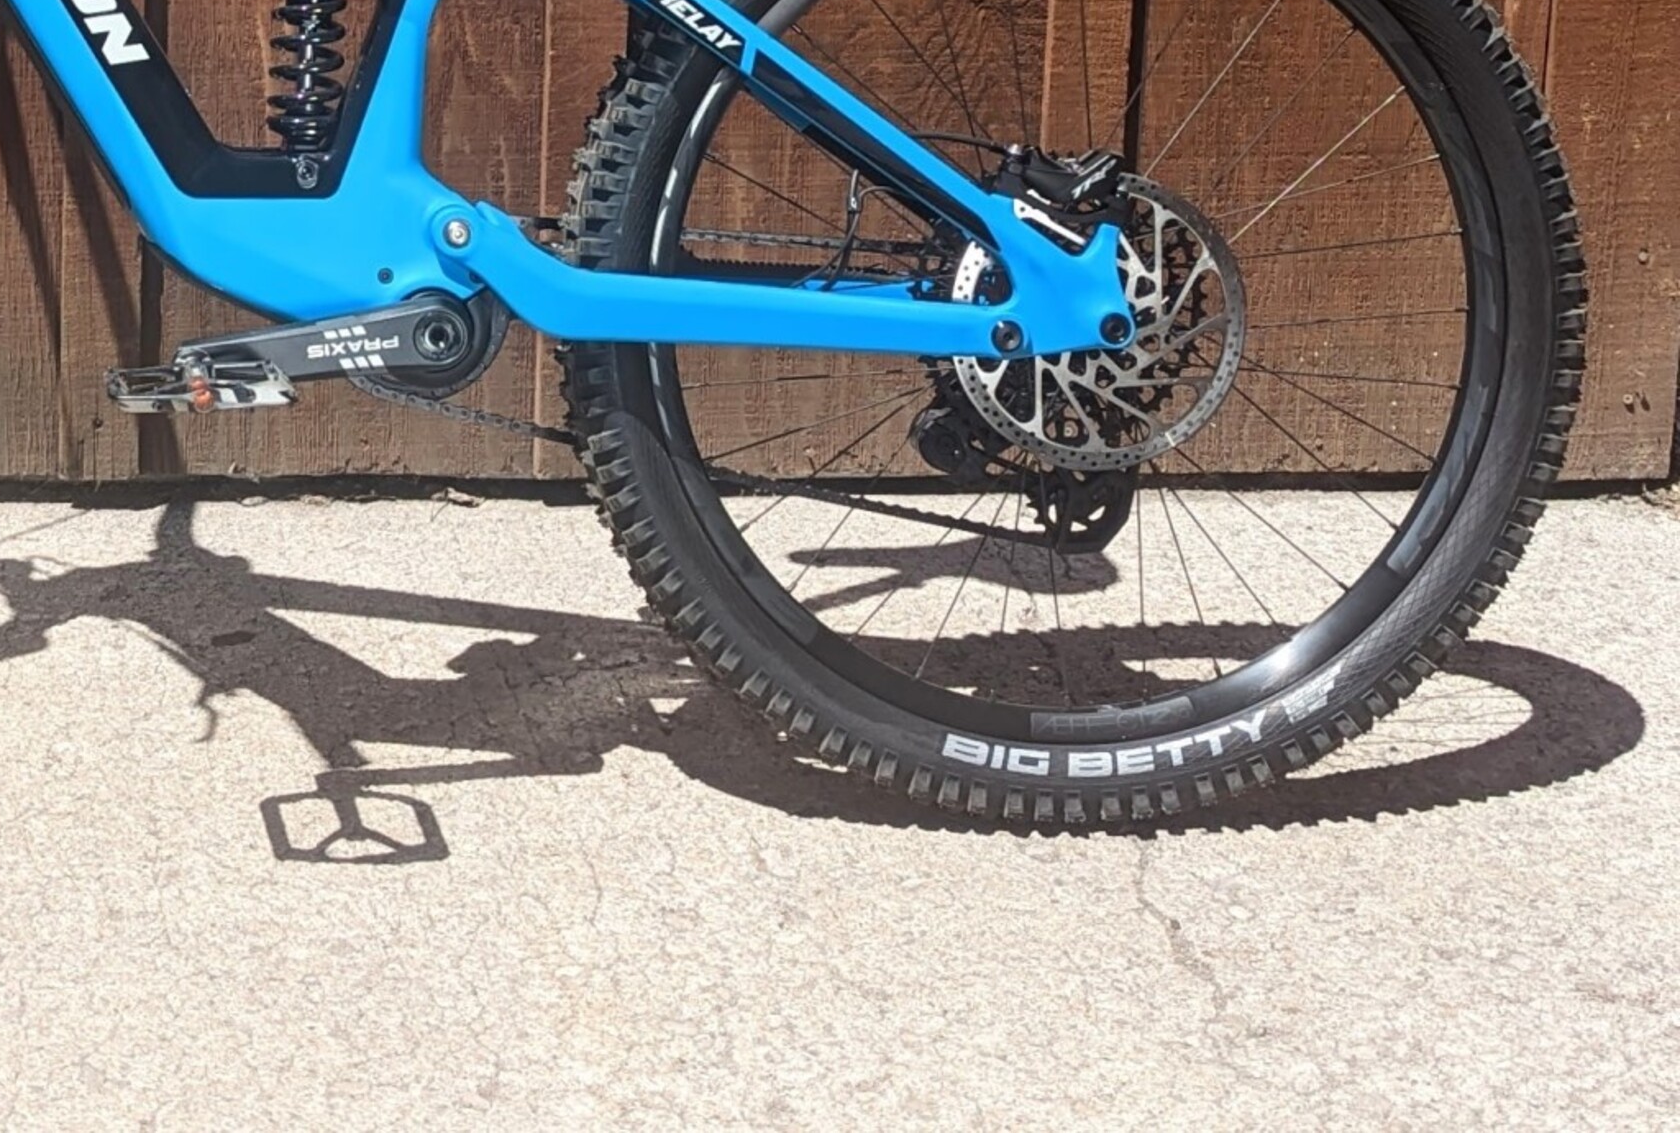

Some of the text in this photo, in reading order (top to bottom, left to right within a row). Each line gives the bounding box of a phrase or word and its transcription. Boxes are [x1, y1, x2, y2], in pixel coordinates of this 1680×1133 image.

[306, 334, 400, 360] PRAXIS
[941, 733, 1051, 777] BIG
[1067, 709, 1268, 778] BETTY
